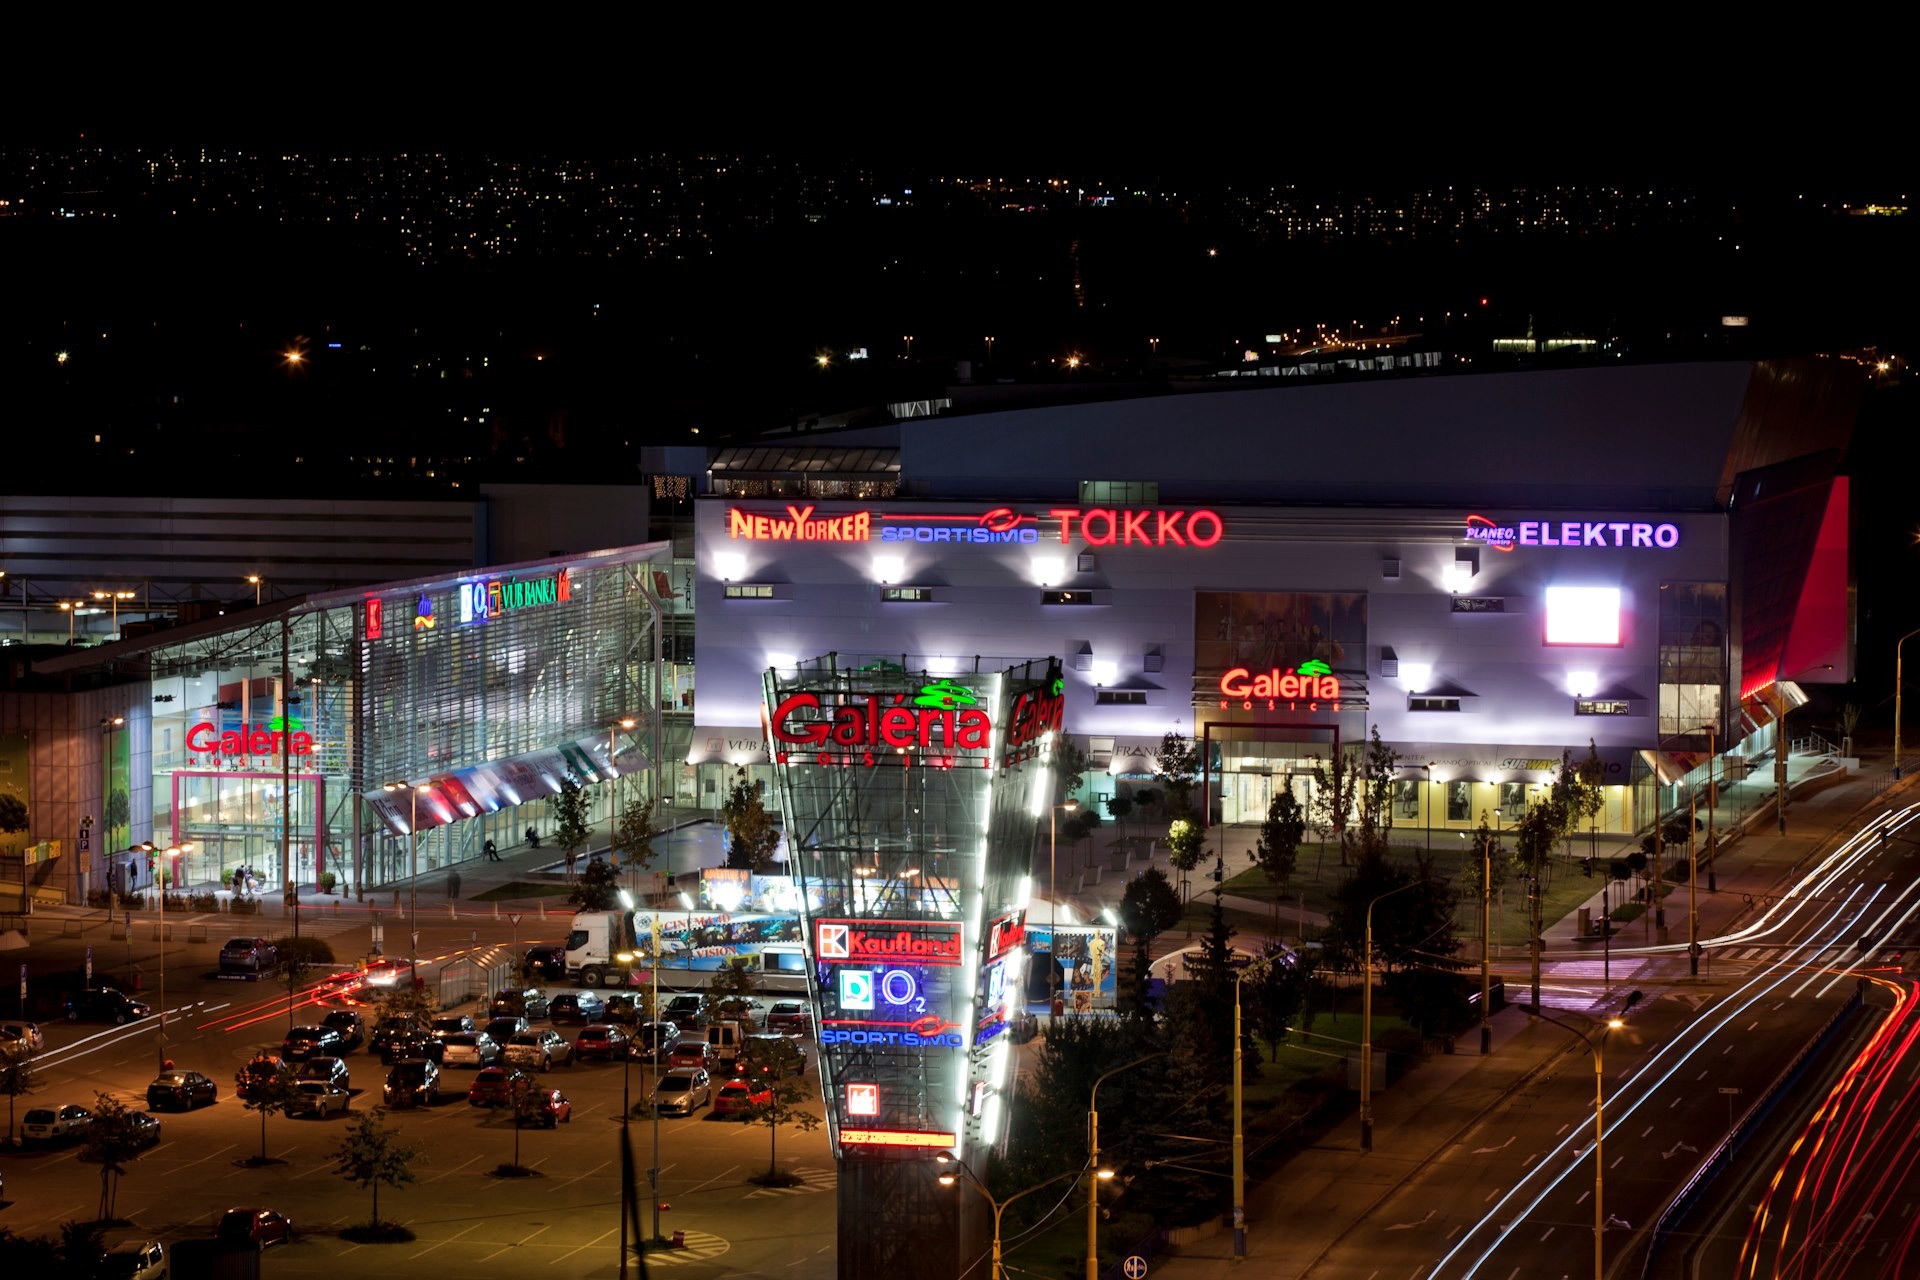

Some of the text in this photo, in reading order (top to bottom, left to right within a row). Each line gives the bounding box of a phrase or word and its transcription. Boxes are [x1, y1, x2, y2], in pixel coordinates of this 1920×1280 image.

[1519, 521, 1679, 549] ELEKTRO
[502, 576, 523, 609] VÚB
[525, 578, 557, 607] BANKA
[1220, 667, 1340, 699] Galéria
[1220, 700, 1340, 712] KOŠICE
[772, 692, 991, 749] Galéria
[186, 721, 313, 756] Galéra
[189, 757, 312, 768] KOŠIE
[1498, 757, 1561, 771] SUBWAY
[696, 945, 737, 959] VISION
[849, 930, 961, 955] Kaufland
